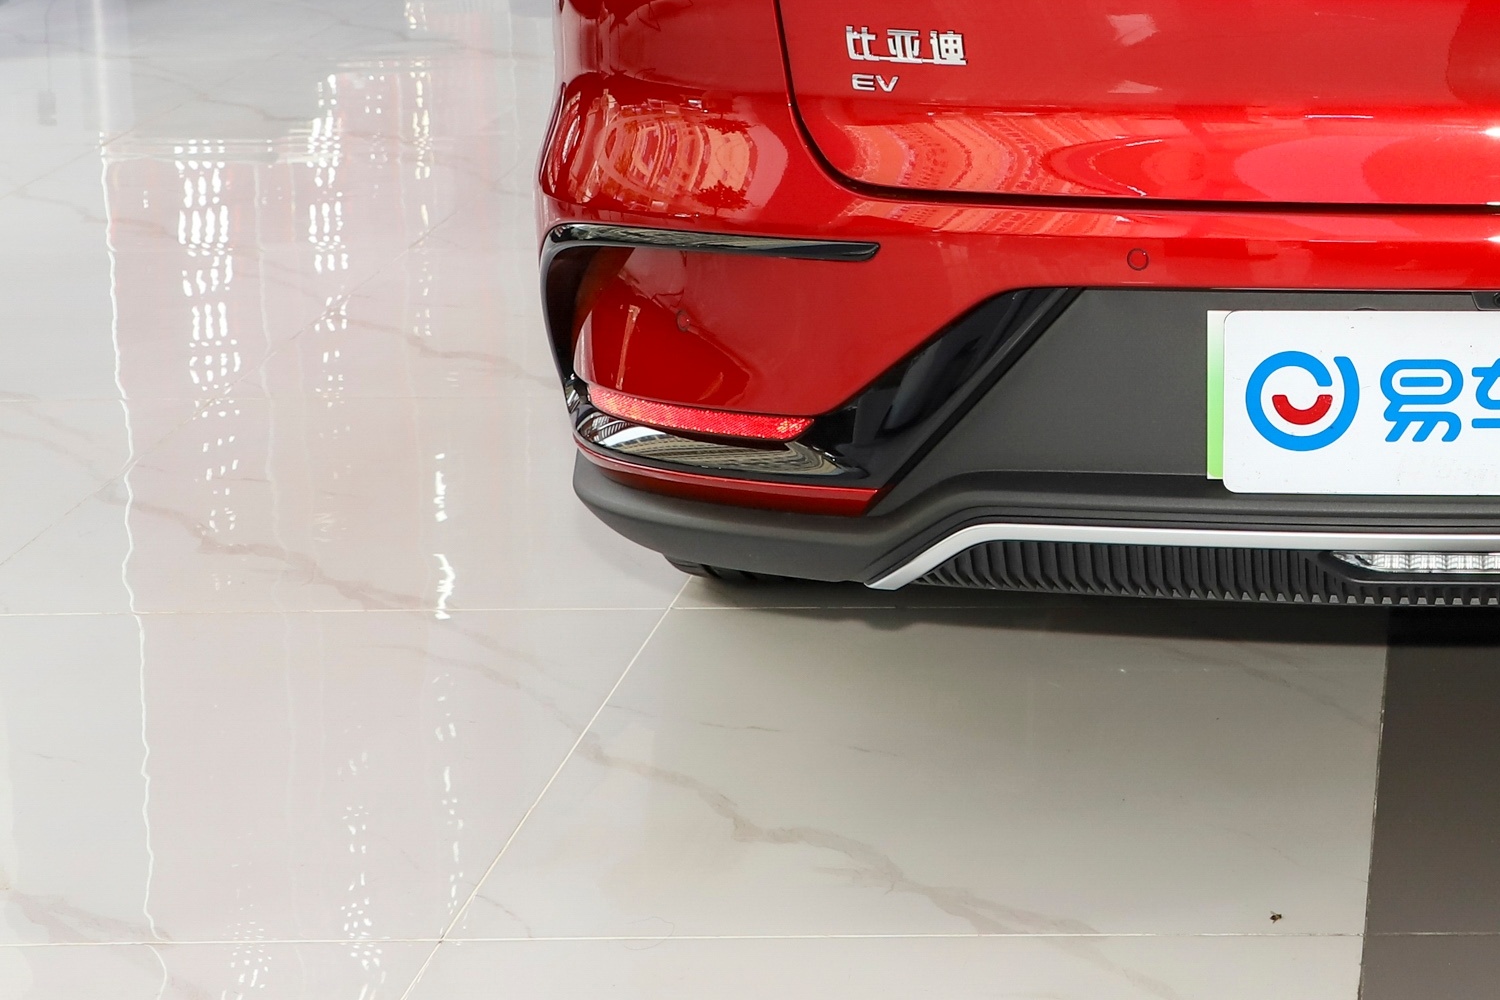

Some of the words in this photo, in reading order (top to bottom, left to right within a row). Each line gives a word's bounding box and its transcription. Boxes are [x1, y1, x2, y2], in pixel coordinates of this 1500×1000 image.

[846, 26, 967, 65] 比亚迪
[852, 73, 898, 92] EV
